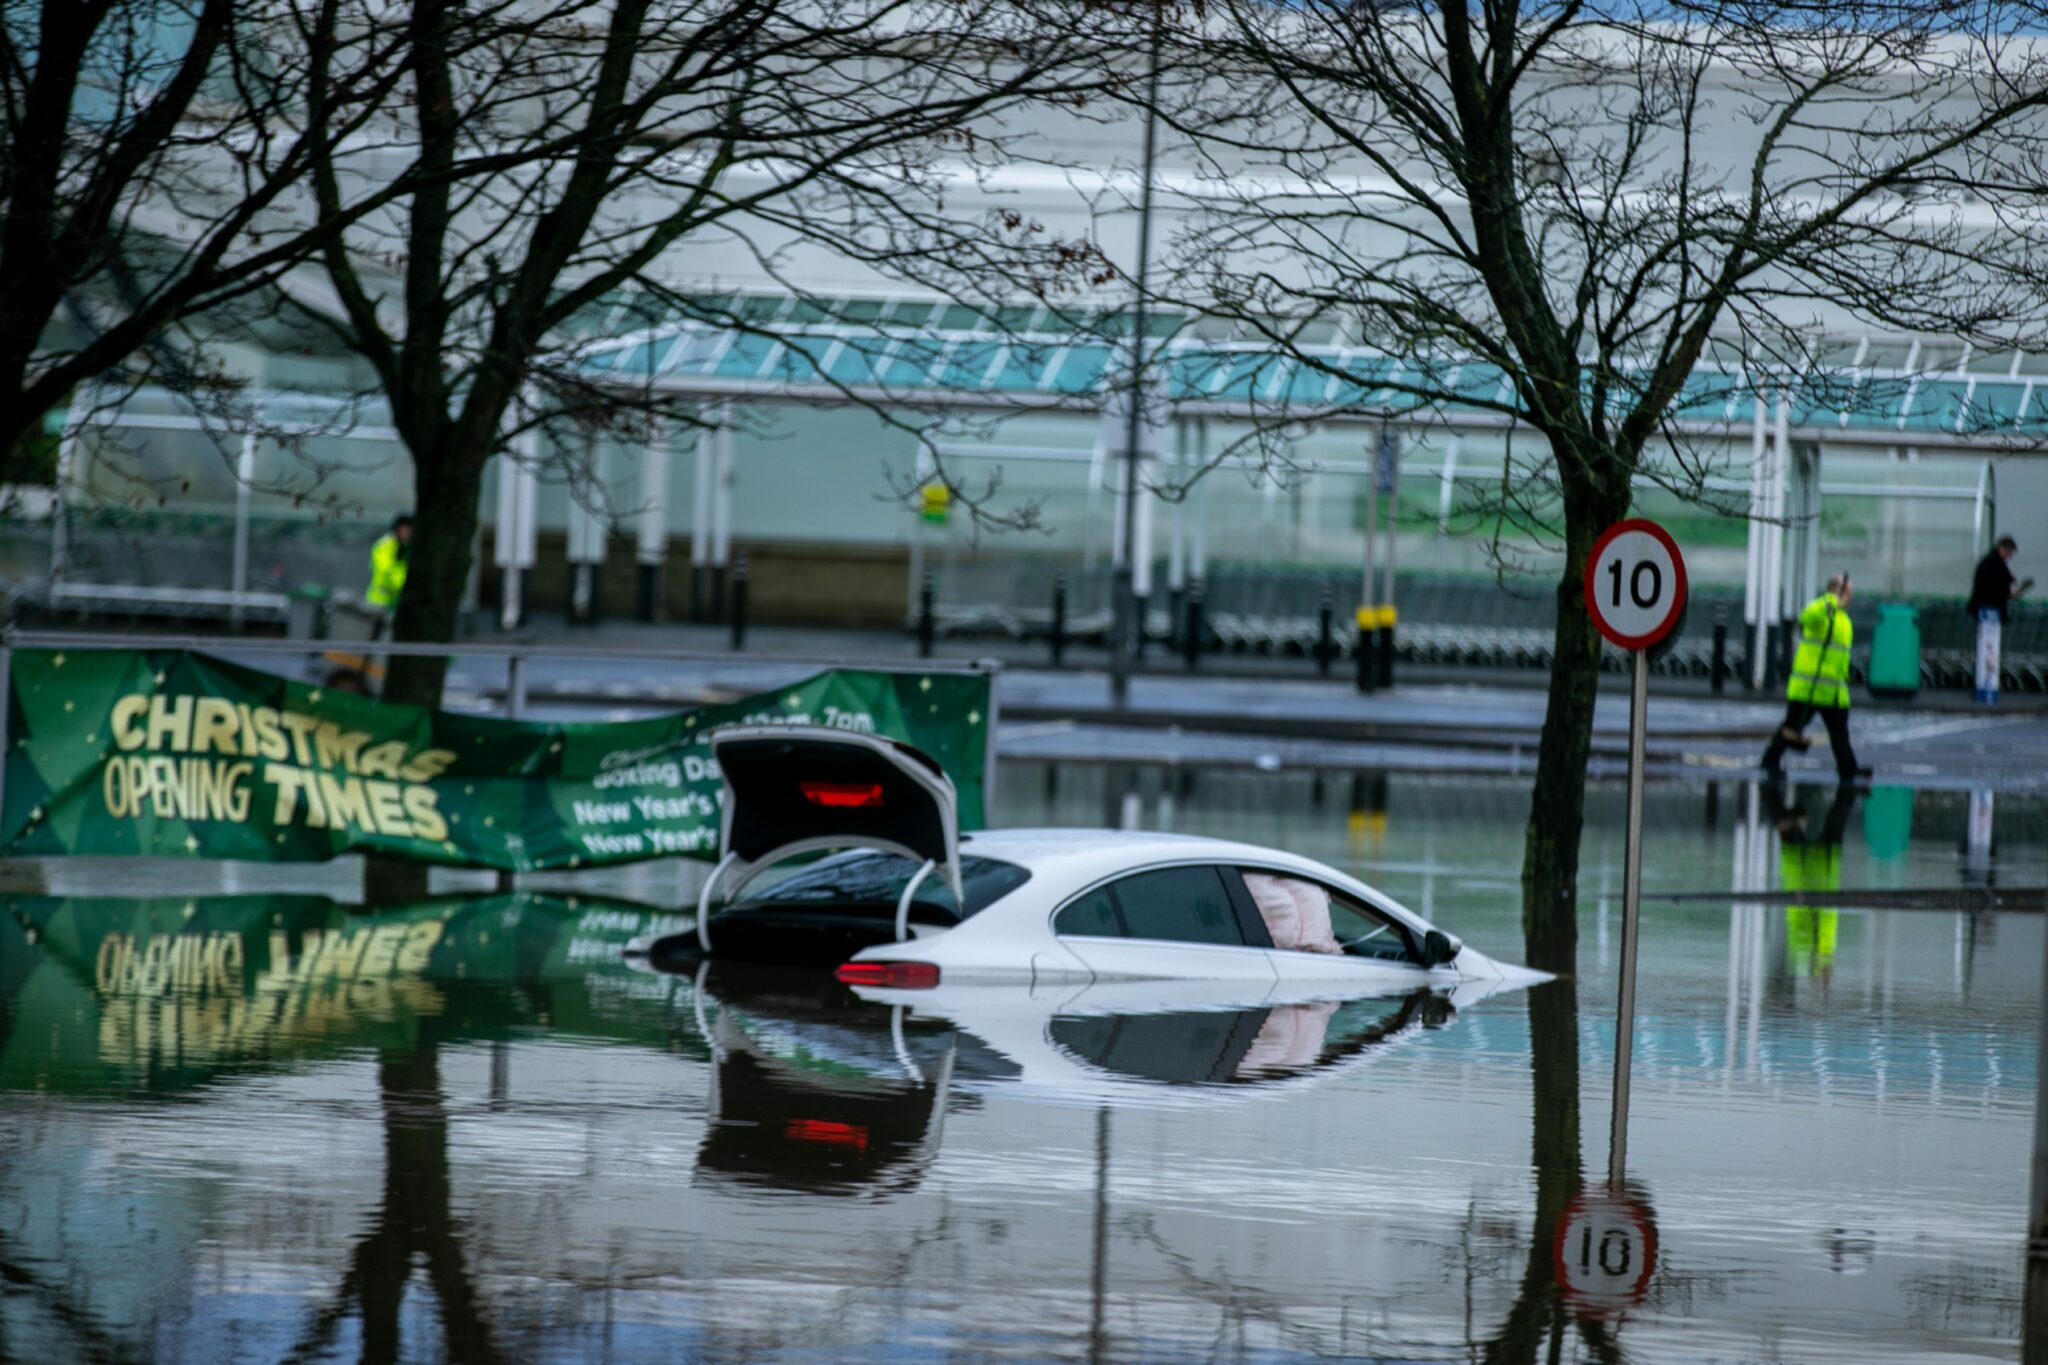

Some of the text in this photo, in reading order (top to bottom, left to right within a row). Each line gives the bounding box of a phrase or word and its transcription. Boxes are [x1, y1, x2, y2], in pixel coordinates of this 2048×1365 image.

[1608, 559, 1662, 609] 10
[110, 694, 458, 783] CHRISTMAS
[683, 755, 723, 782] Da
[104, 756, 449, 842] OPENING TIMES
[572, 799, 631, 826] New
[632, 791, 714, 821] Year's
[582, 825, 717, 854] New Year's
